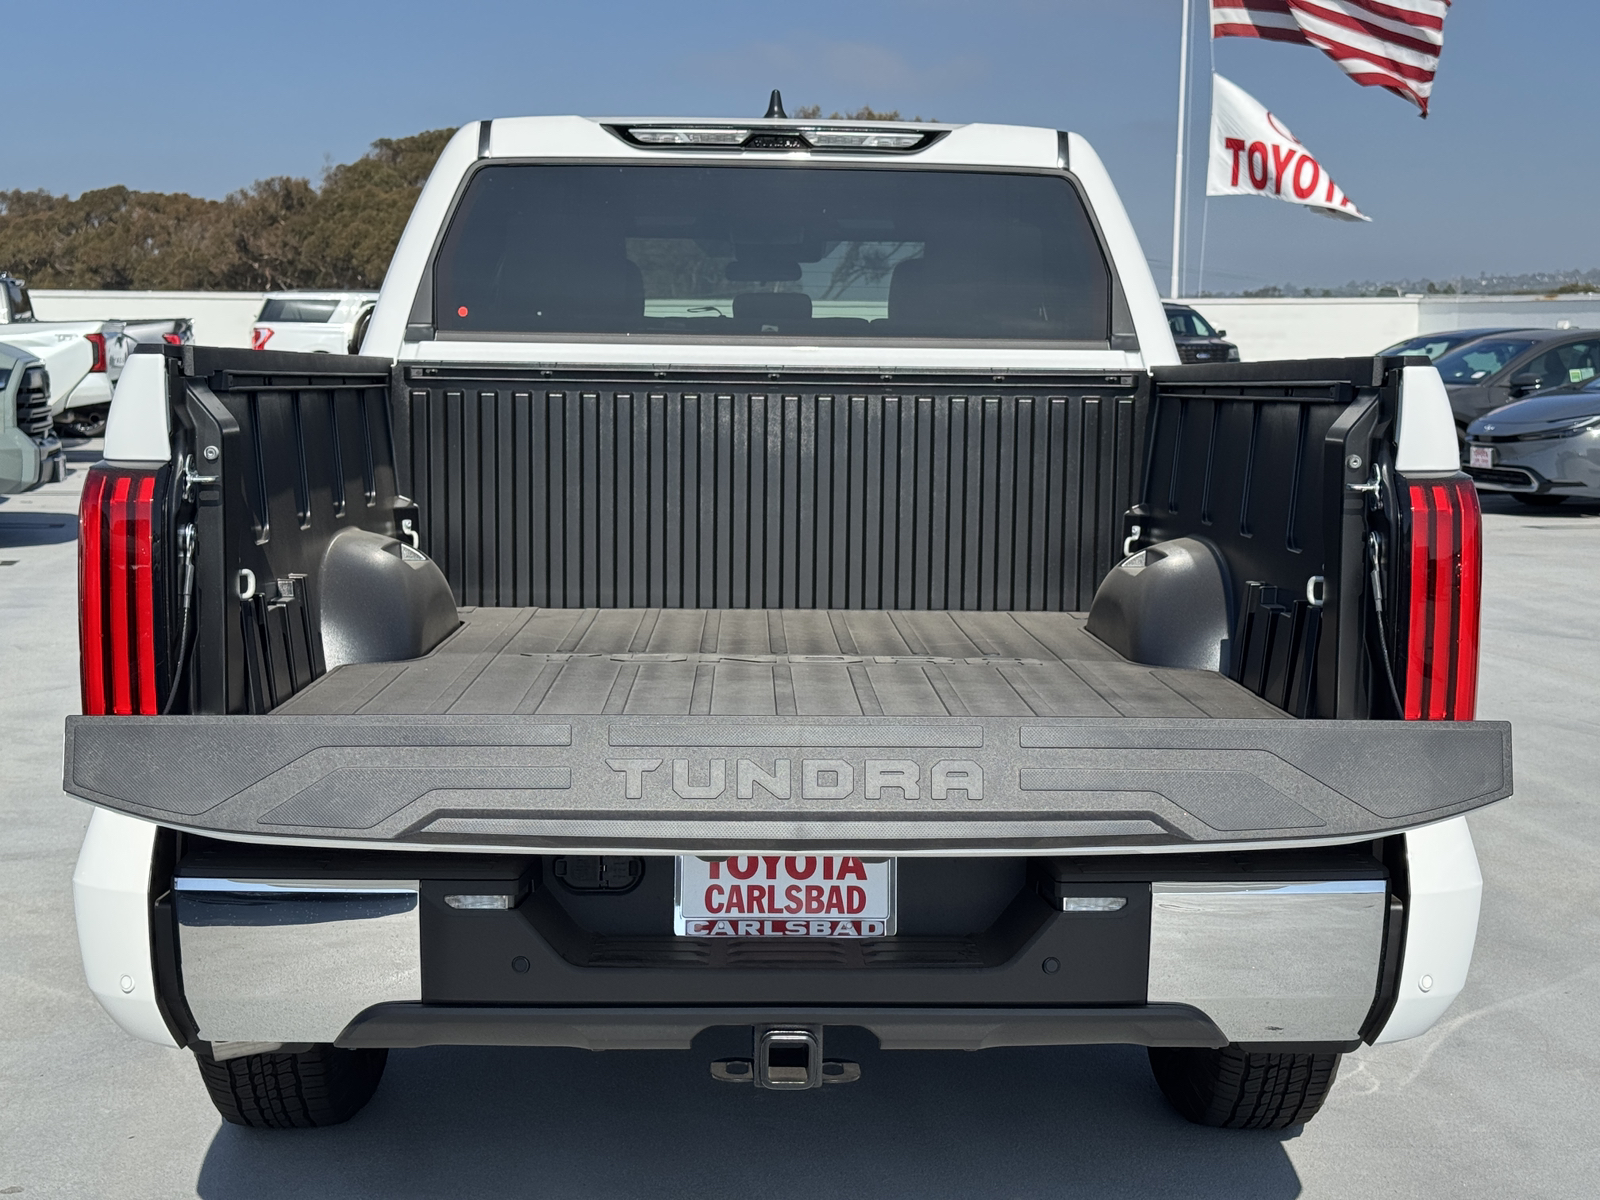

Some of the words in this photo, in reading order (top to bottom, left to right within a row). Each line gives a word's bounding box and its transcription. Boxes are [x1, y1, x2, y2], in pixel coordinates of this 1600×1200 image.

[1225, 137, 1350, 207] TOYO
[605, 758, 984, 800] TUNDRA
[704, 884, 867, 914] CARLSBAD
[687, 920, 884, 936] CARLSBAD
